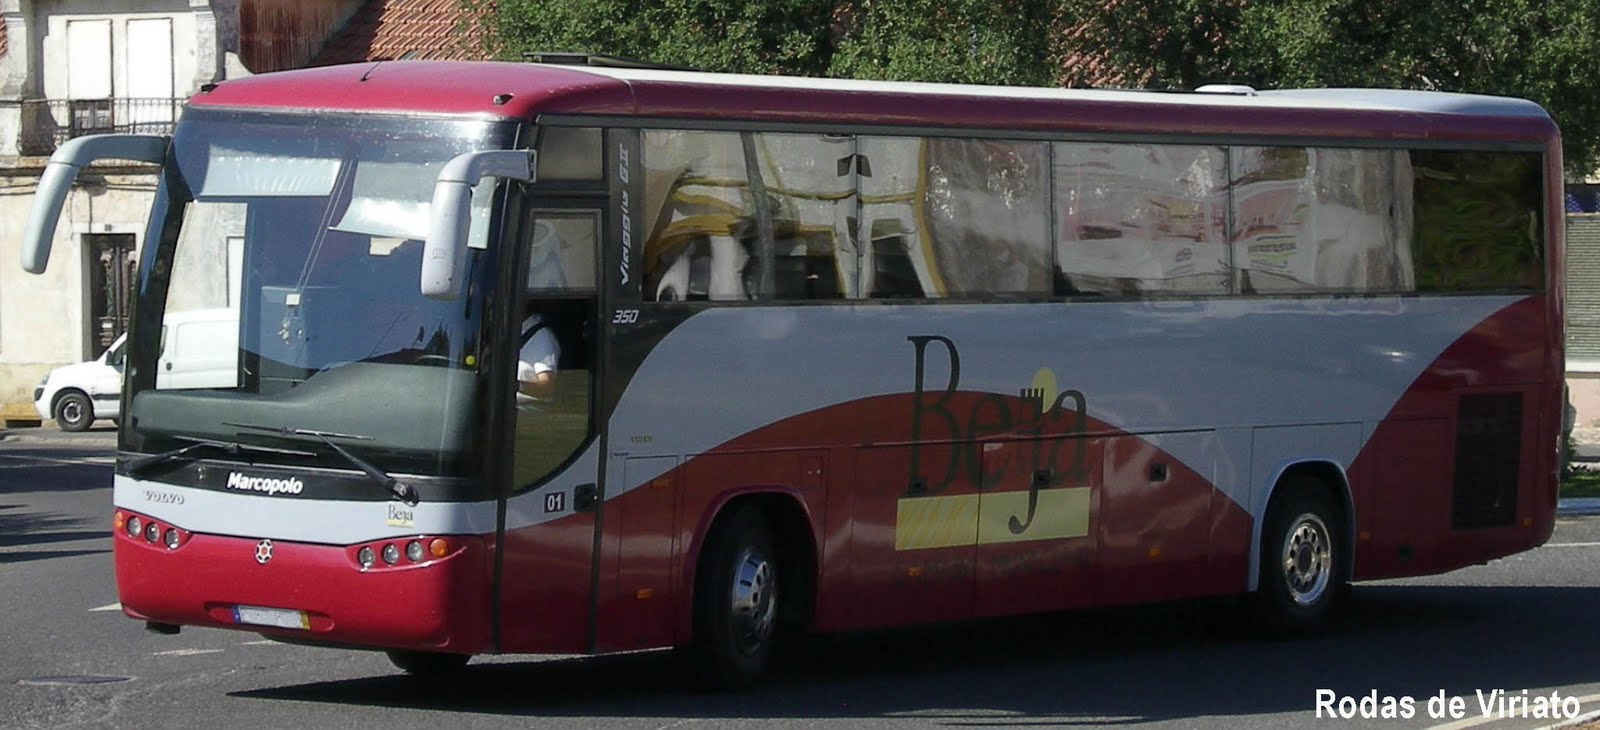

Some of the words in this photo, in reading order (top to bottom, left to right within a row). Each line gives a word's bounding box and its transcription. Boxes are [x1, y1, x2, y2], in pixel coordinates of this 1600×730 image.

[612, 309, 640, 324] 350
[906, 334, 1088, 535] Beja
[226, 472, 304, 496] Marcopolo
[144, 490, 186, 505] VOLVO
[546, 493, 563, 511] 01
[387, 504, 414, 525] Beja
